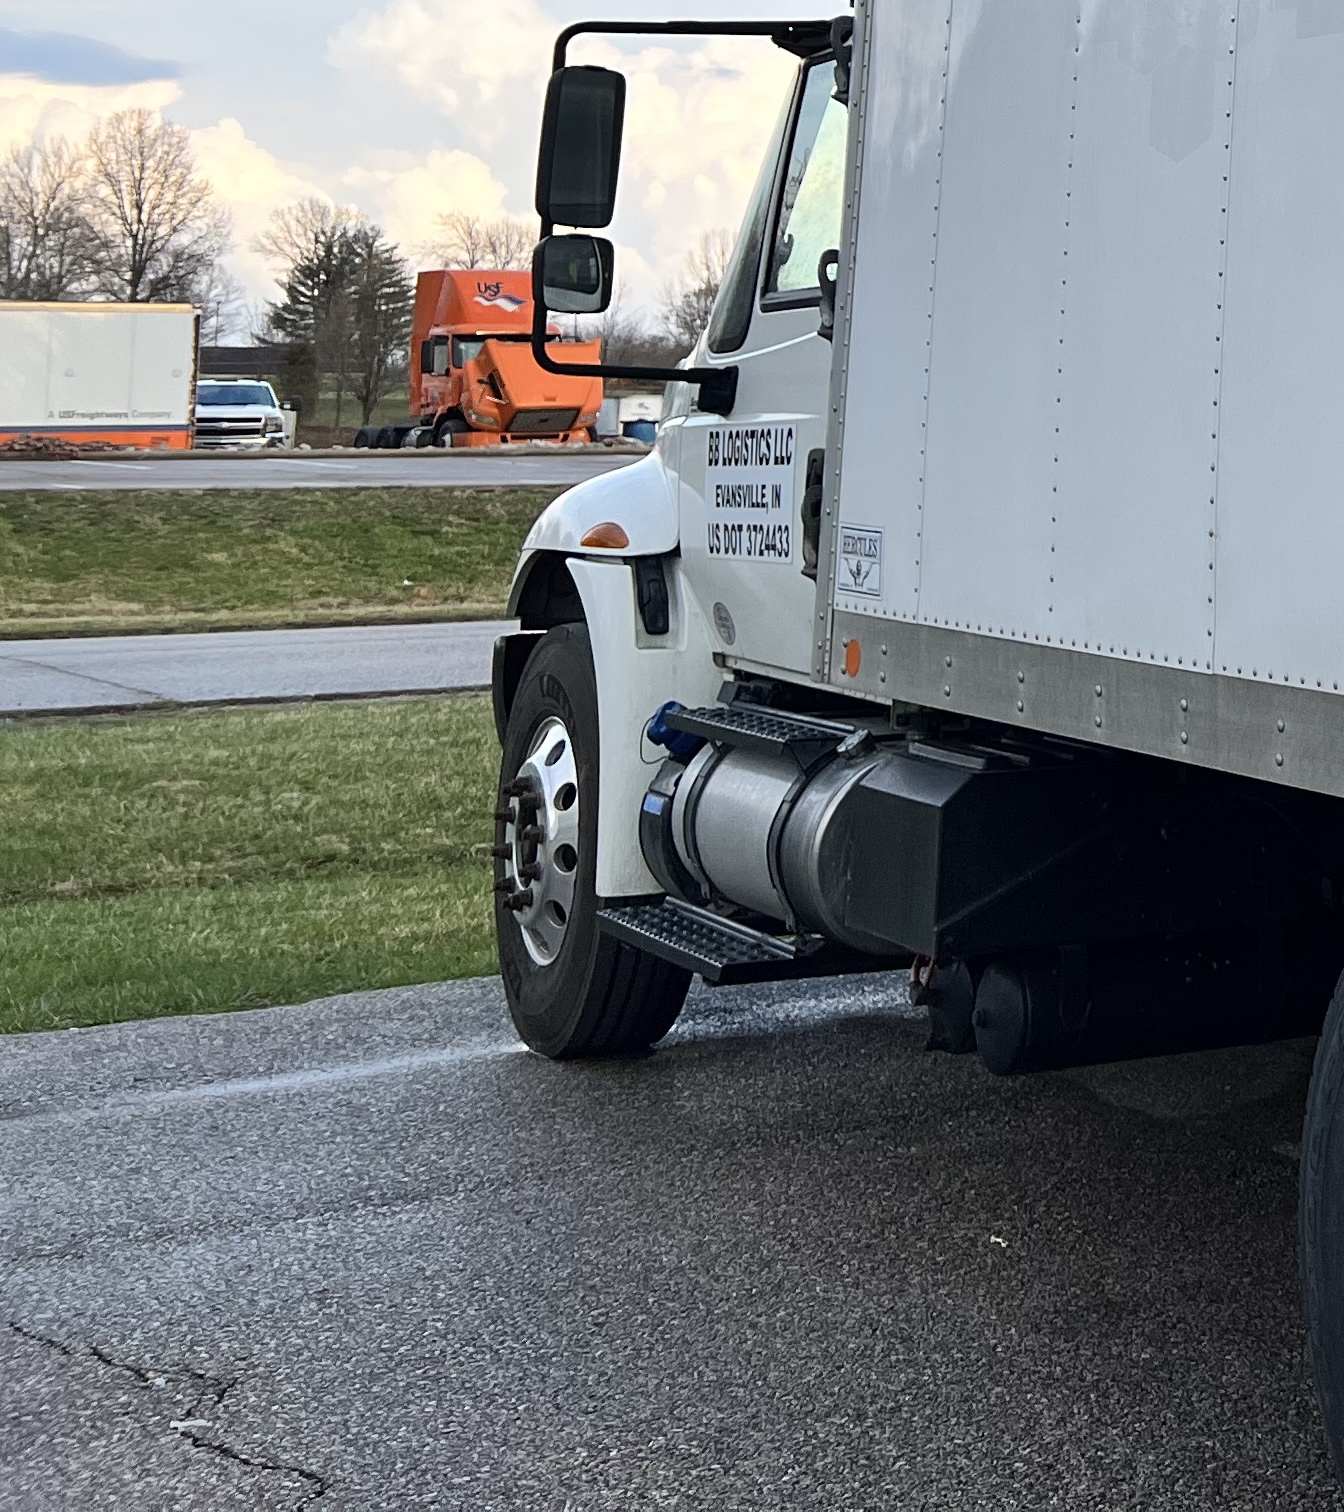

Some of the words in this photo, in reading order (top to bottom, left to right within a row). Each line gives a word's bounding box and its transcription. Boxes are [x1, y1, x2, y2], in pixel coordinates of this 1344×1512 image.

[477, 281, 503, 297] USF
[708, 431, 720, 466] BB
[722, 428, 771, 466] LOGISTICS
[774, 427, 793, 465] LLC
[715, 484, 769, 514] EVANSVILLE,
[771, 484, 782, 508] IN
[707, 523, 721, 554] US
[723, 523, 743, 555] DOT
[746, 524, 790, 558] 3724433
